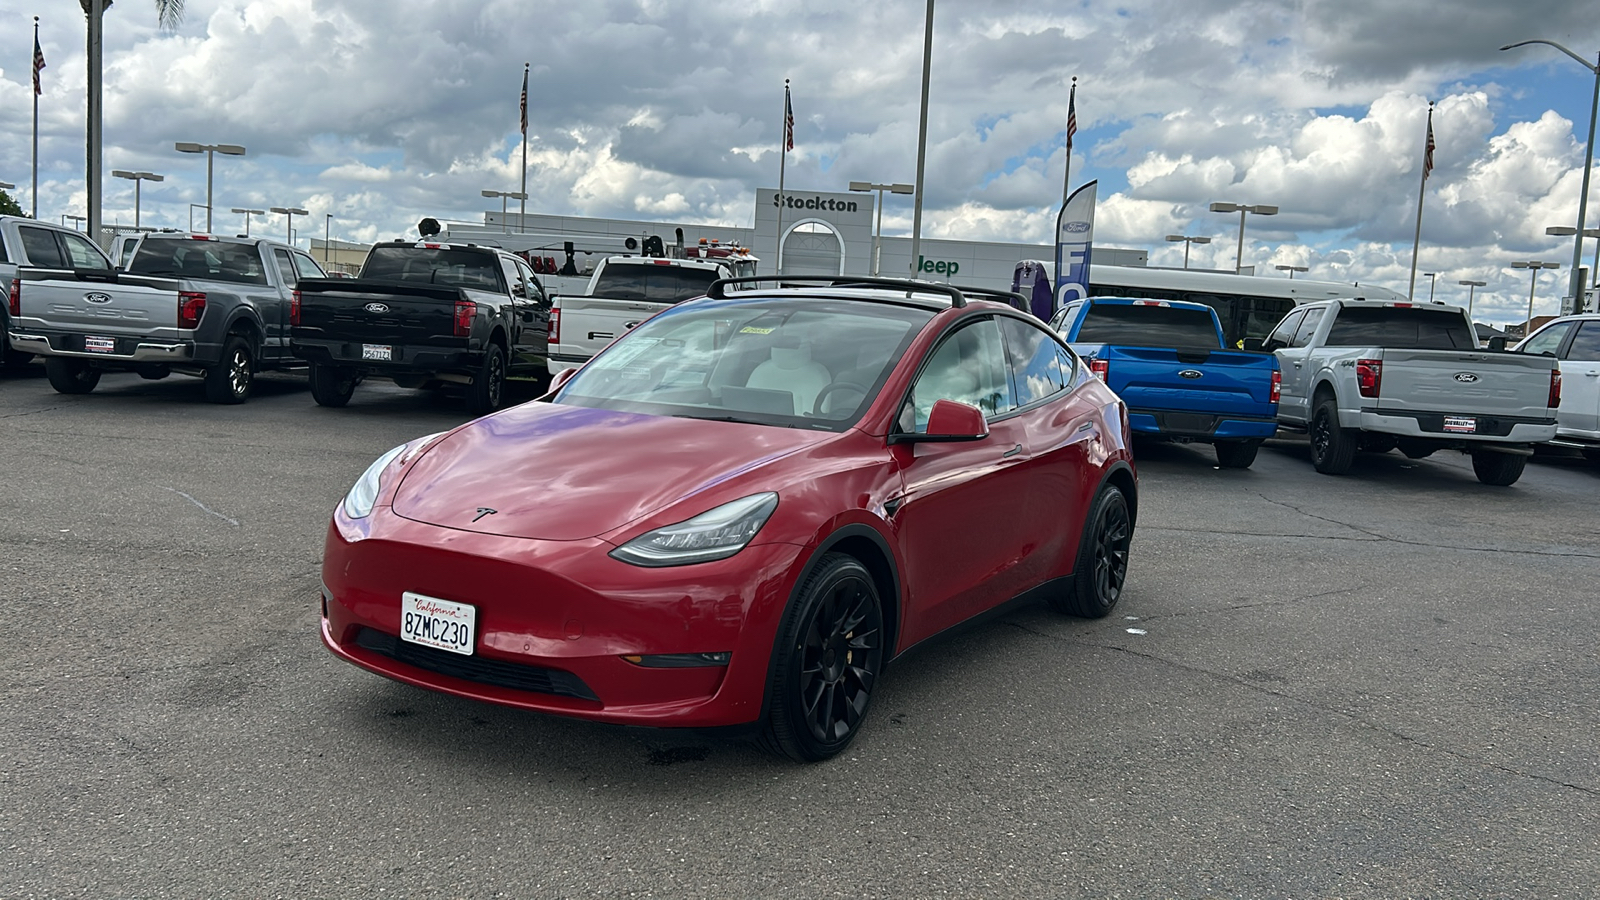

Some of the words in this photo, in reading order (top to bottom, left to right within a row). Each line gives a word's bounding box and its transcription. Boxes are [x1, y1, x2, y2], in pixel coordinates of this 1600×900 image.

[773, 192, 858, 213] Stockton
[1066, 222, 1088, 232] Ford
[909, 254, 960, 277] Jeep
[89, 293, 107, 302] Ford
[1457, 373, 1475, 383] Ford
[416, 600, 460, 618] California
[405, 612, 468, 646] 8ZMC230
